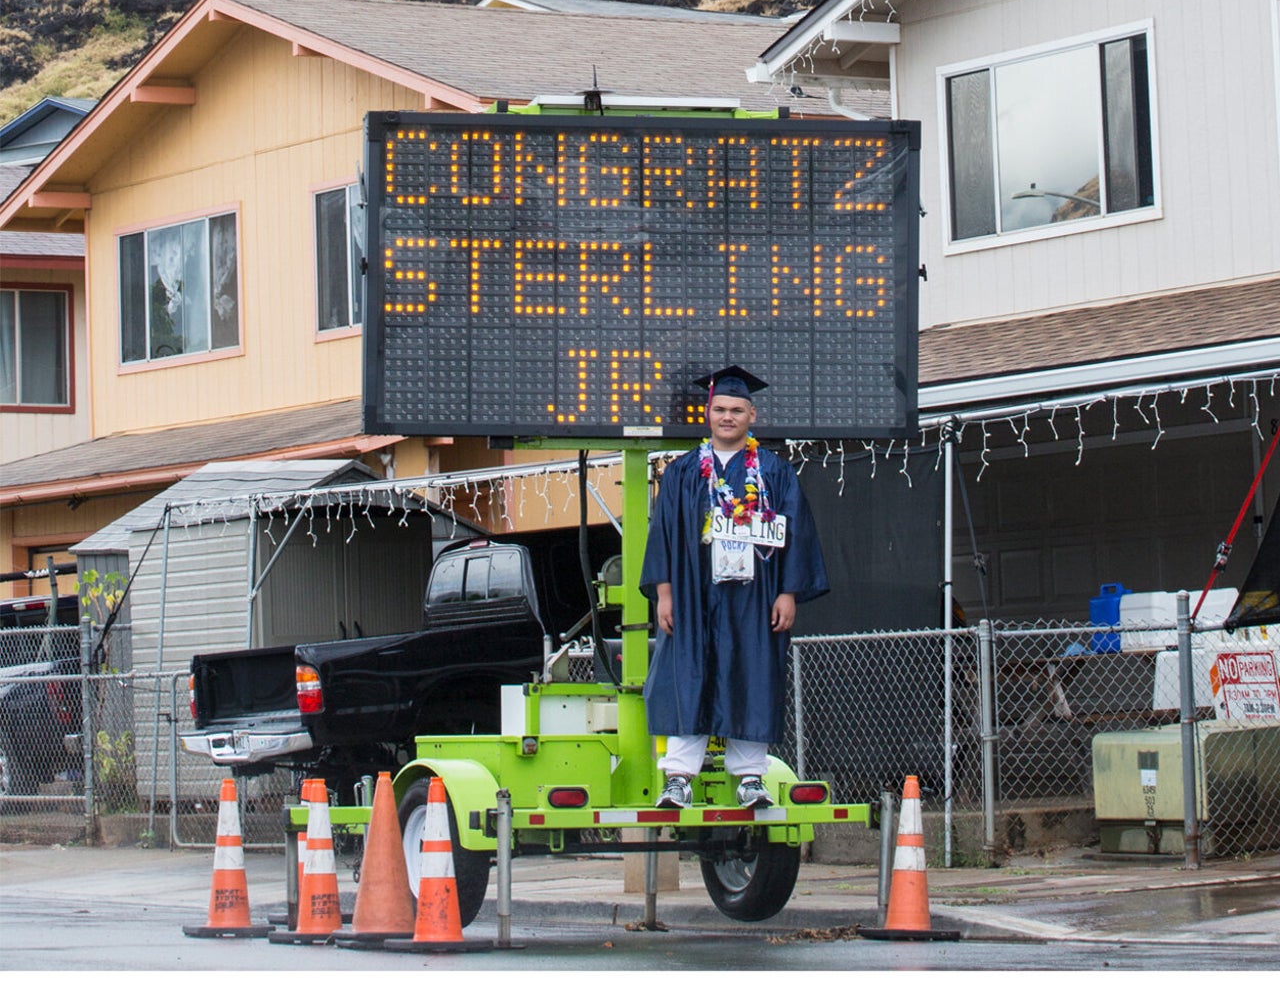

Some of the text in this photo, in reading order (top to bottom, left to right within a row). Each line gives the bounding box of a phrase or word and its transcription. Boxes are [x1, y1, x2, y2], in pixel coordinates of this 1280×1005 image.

[386, 131, 885, 211] CONGRATZ
[385, 237, 885, 318] STERLING
[547, 349, 705, 423] JR.
[714, 514, 785, 541] STELING
[1218, 658, 1273, 680] NO PARKING
